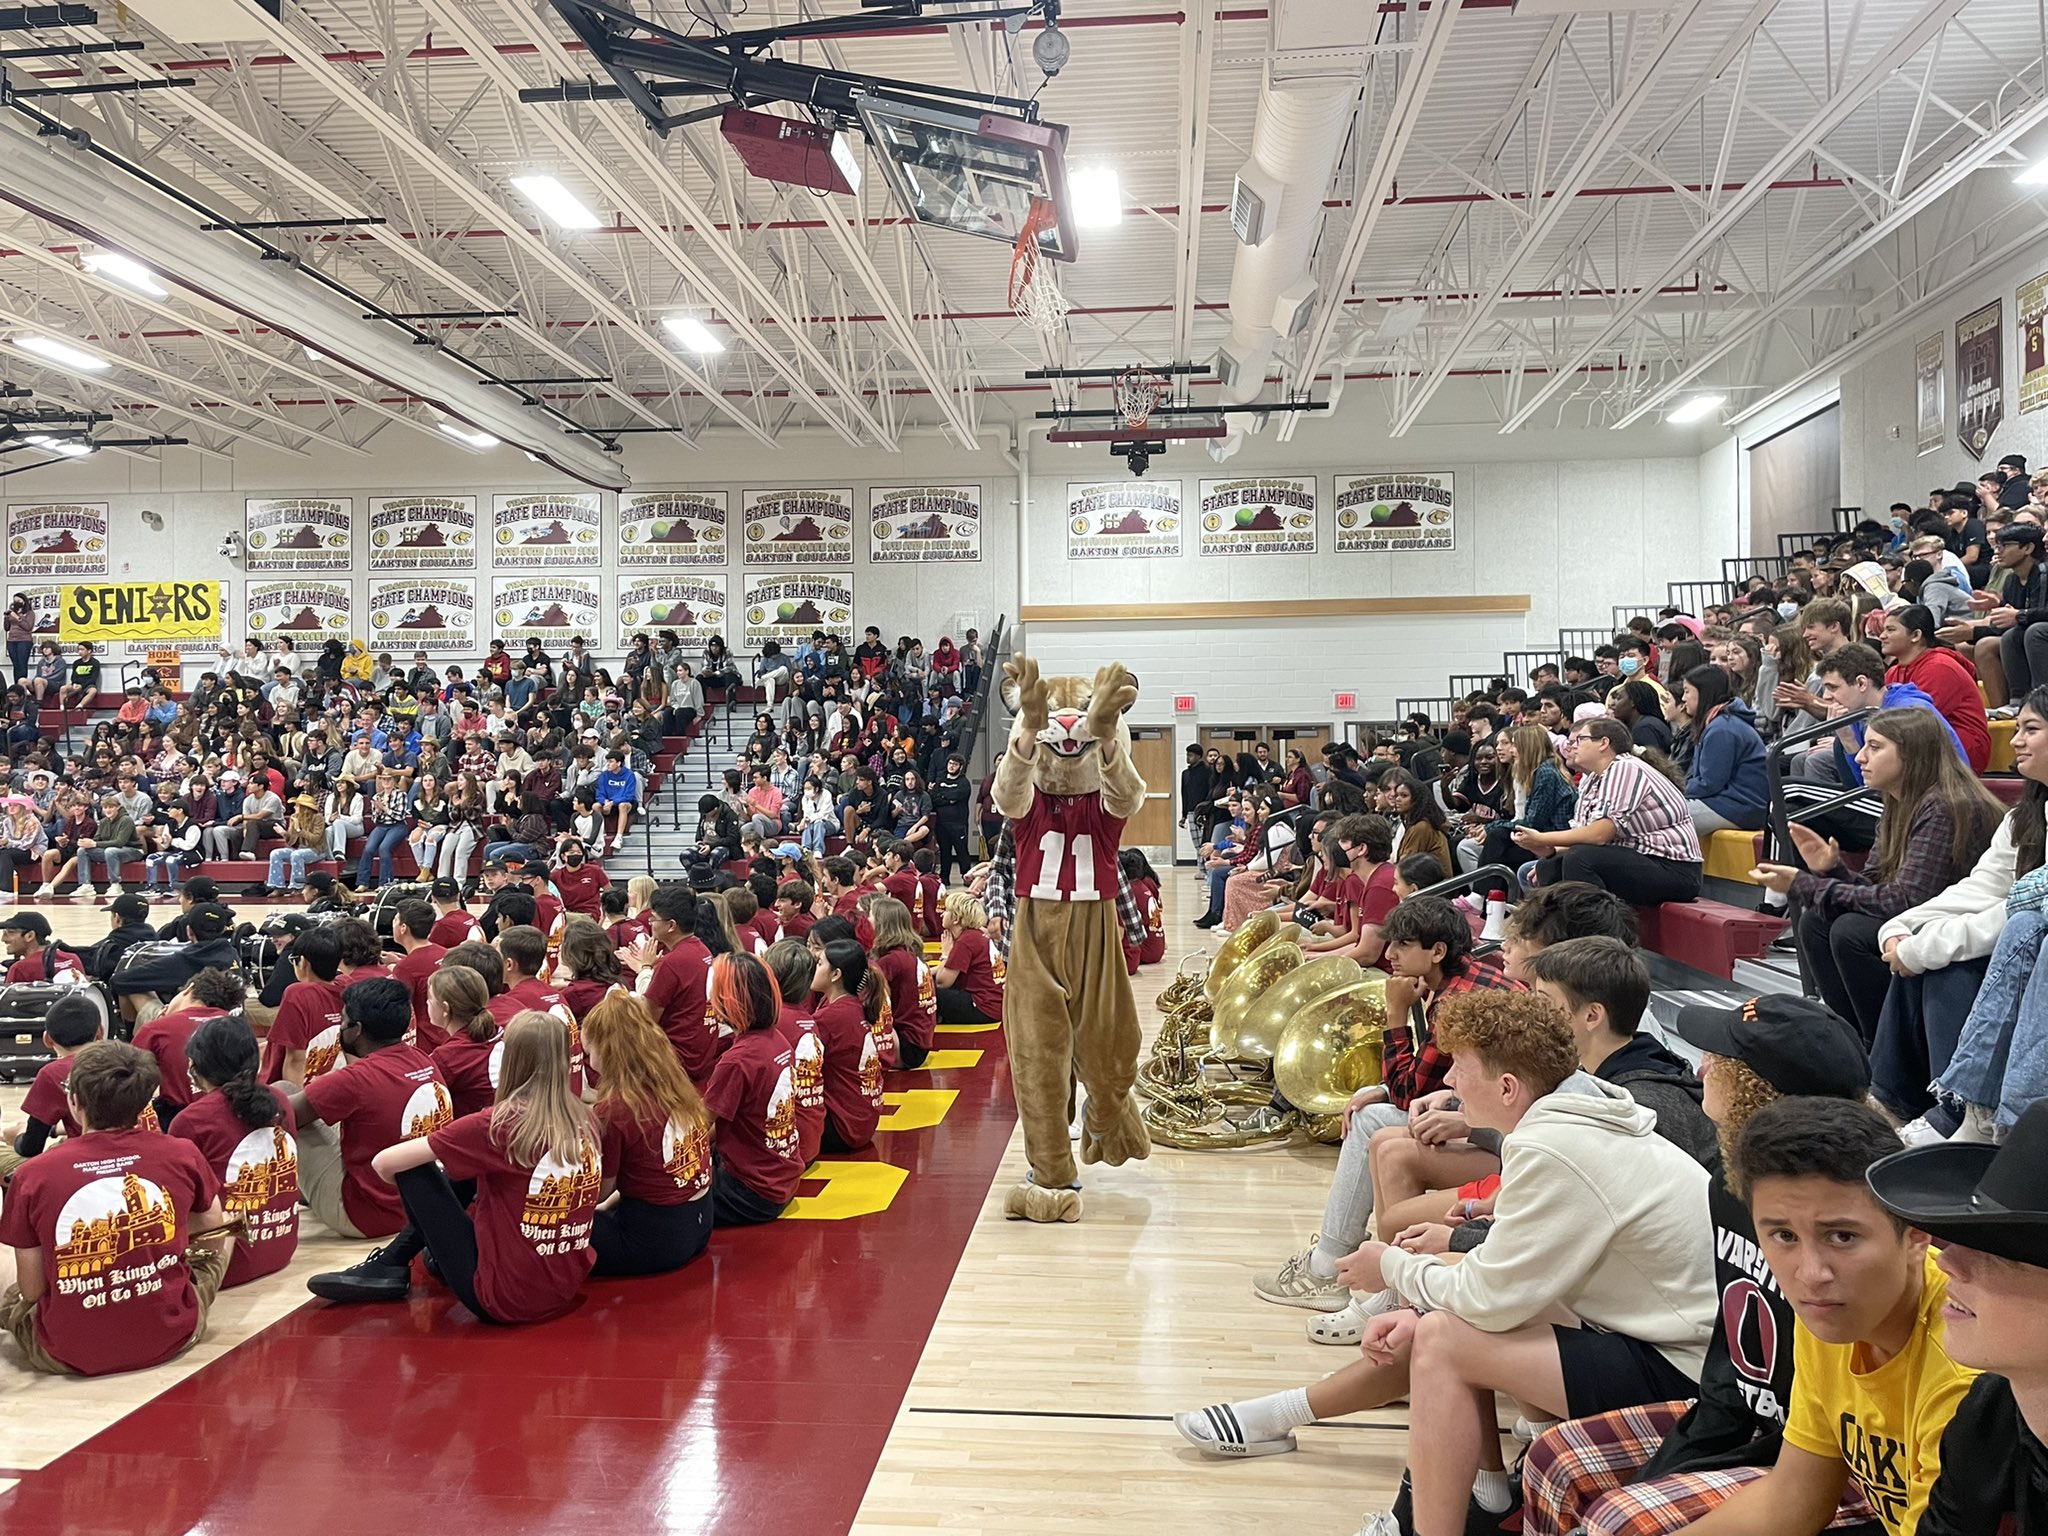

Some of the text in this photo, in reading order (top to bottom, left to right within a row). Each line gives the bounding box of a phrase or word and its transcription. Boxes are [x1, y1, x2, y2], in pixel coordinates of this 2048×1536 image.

[1070, 492, 1179, 517] STATE CHAMPIONS
[1202, 488, 1314, 513] STATE CHAMPIONS
[1337, 484, 1451, 510] STATE CHAMPIONS
[249, 509, 349, 531] STATE CHAMPIONS
[372, 507, 474, 530] STATE CHAMPIONS
[495, 505, 599, 527] STATE CHAMPIONS
[620, 502, 725, 526] STATE CHAMPIONS
[745, 500, 850, 524] STATE CHAMPIONS
[873, 497, 978, 521] STATE CHAMPIONS
[9, 513, 105, 537] STATE CHAMPIONS
[873, 552, 919, 560] OAKTON
[1071, 548, 1118, 556] OAKTON
[1203, 544, 1251, 553] OAKTON
[1338, 541, 1388, 550] OAKTON
[249, 561, 294, 569] OAKTON
[372, 560, 417, 568] OAKTON
[495, 557, 541, 565] OAKTON
[621, 556, 667, 564] OAKTON
[746, 554, 793, 562] OAKTON
[9, 566, 52, 574] OAKTON
[248, 590, 349, 612] STATE CHAMPIONS
[371, 589, 473, 611] STATE CHAMPIONS
[495, 587, 598, 609] STATE CHAMPIONS
[620, 586, 725, 608] STATE CHAMPIONS
[746, 583, 851, 607] STATE CHAMPIONS
[148, 651, 180, 659] HOME
[371, 641, 416, 649] OAKTON
[1030, 830, 1100, 901] 11
[520, 1222, 556, 1242] When
[56, 1255, 178, 1294] When Kings Go
[110, 1288, 131, 1302] To
[135, 1279, 162, 1296] War
[1220, 1444, 1246, 1452] adidas
